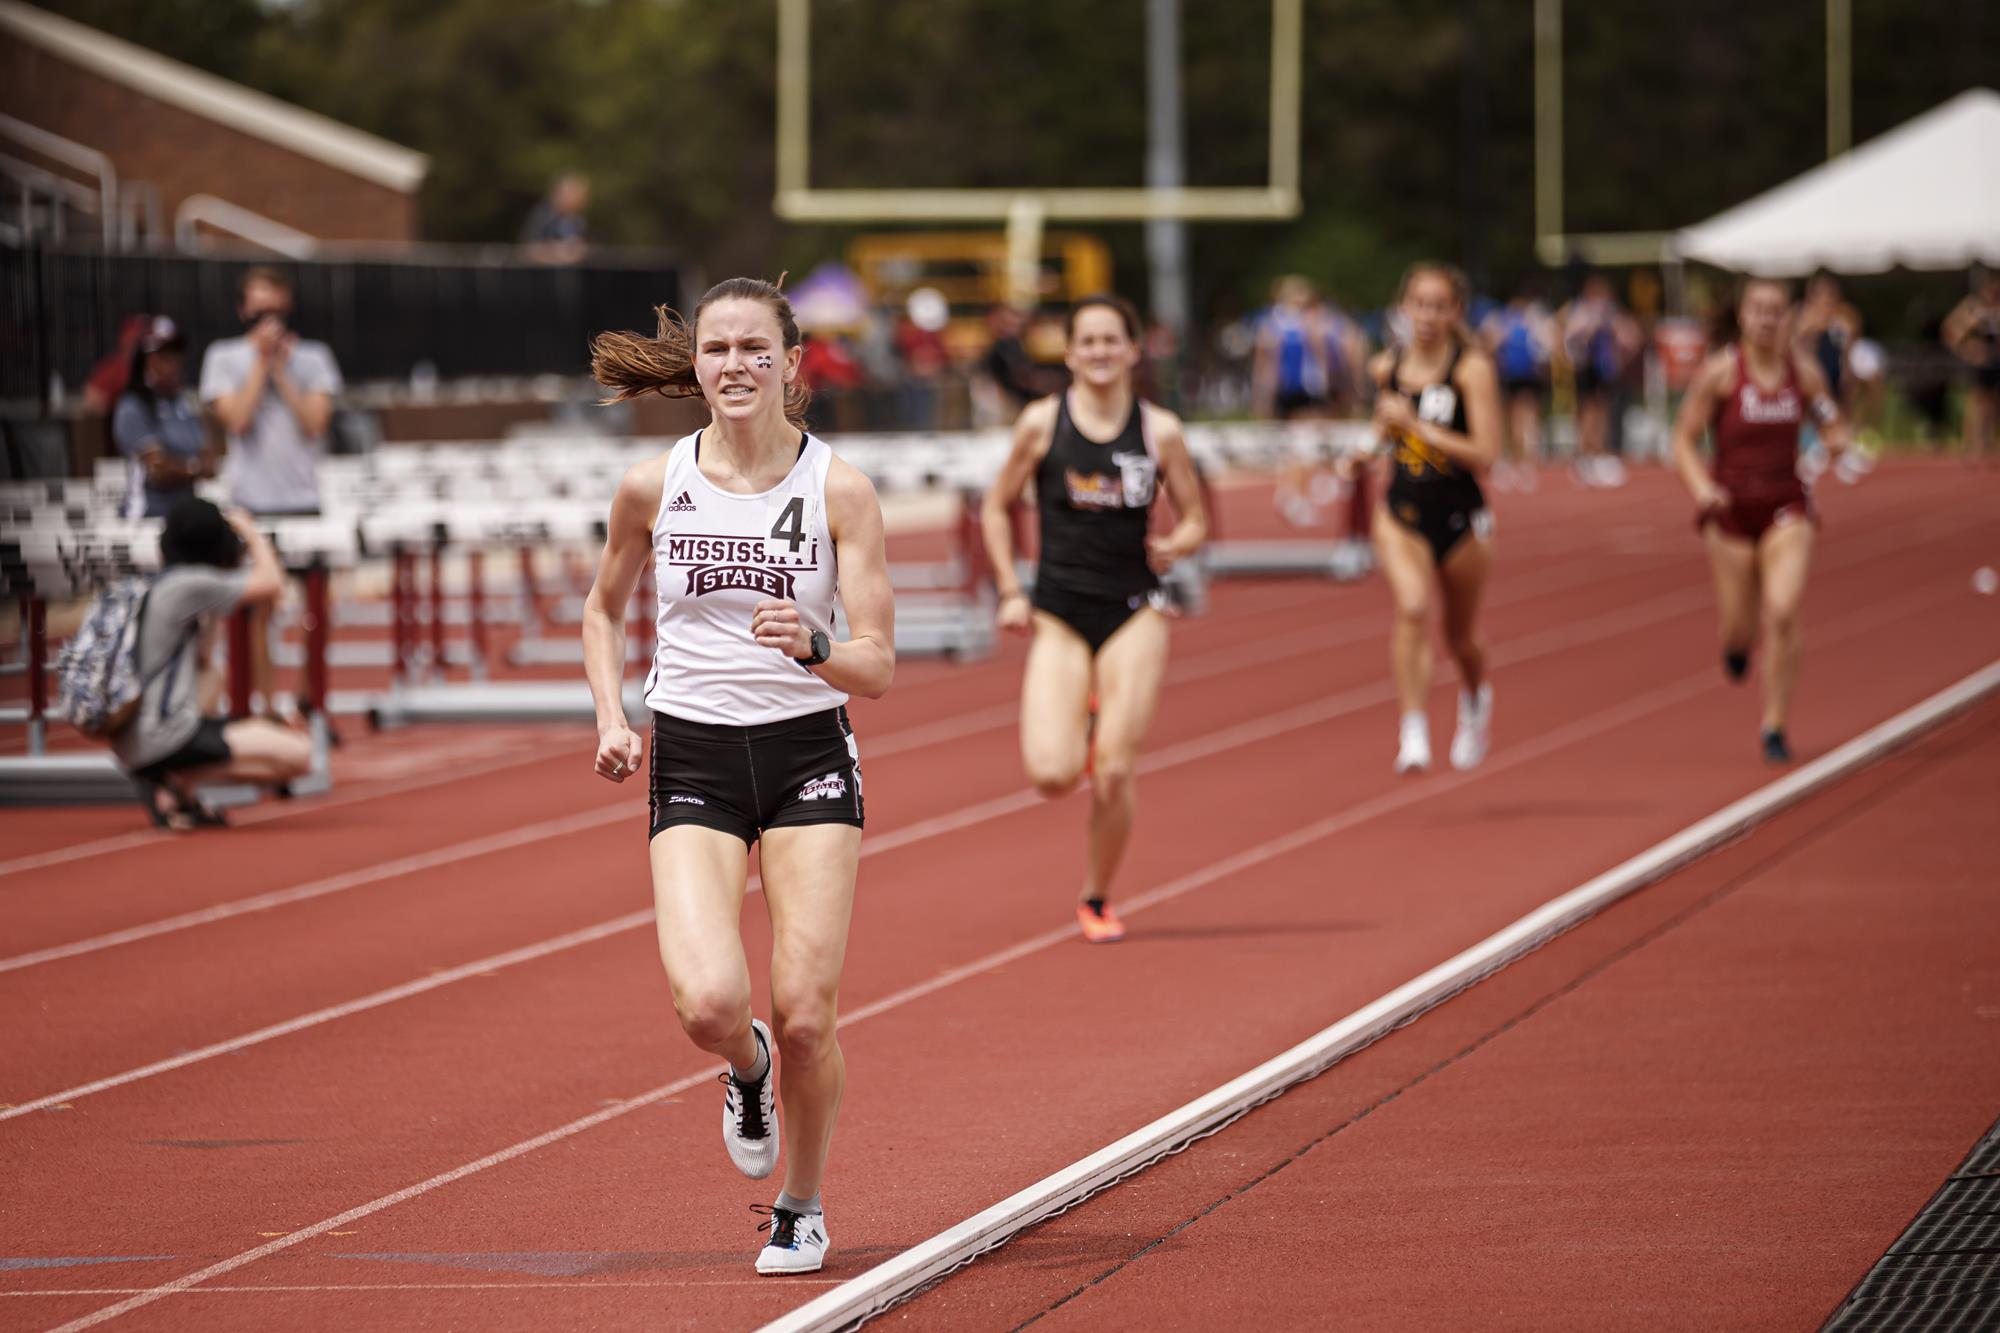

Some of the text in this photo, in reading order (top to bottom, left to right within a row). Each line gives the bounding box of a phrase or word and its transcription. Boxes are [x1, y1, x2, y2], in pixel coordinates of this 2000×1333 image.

[668, 504, 697, 512] adidas
[771, 496, 806, 553] 4
[669, 539, 818, 565] MISSISSI
[703, 569, 776, 592] STATE
